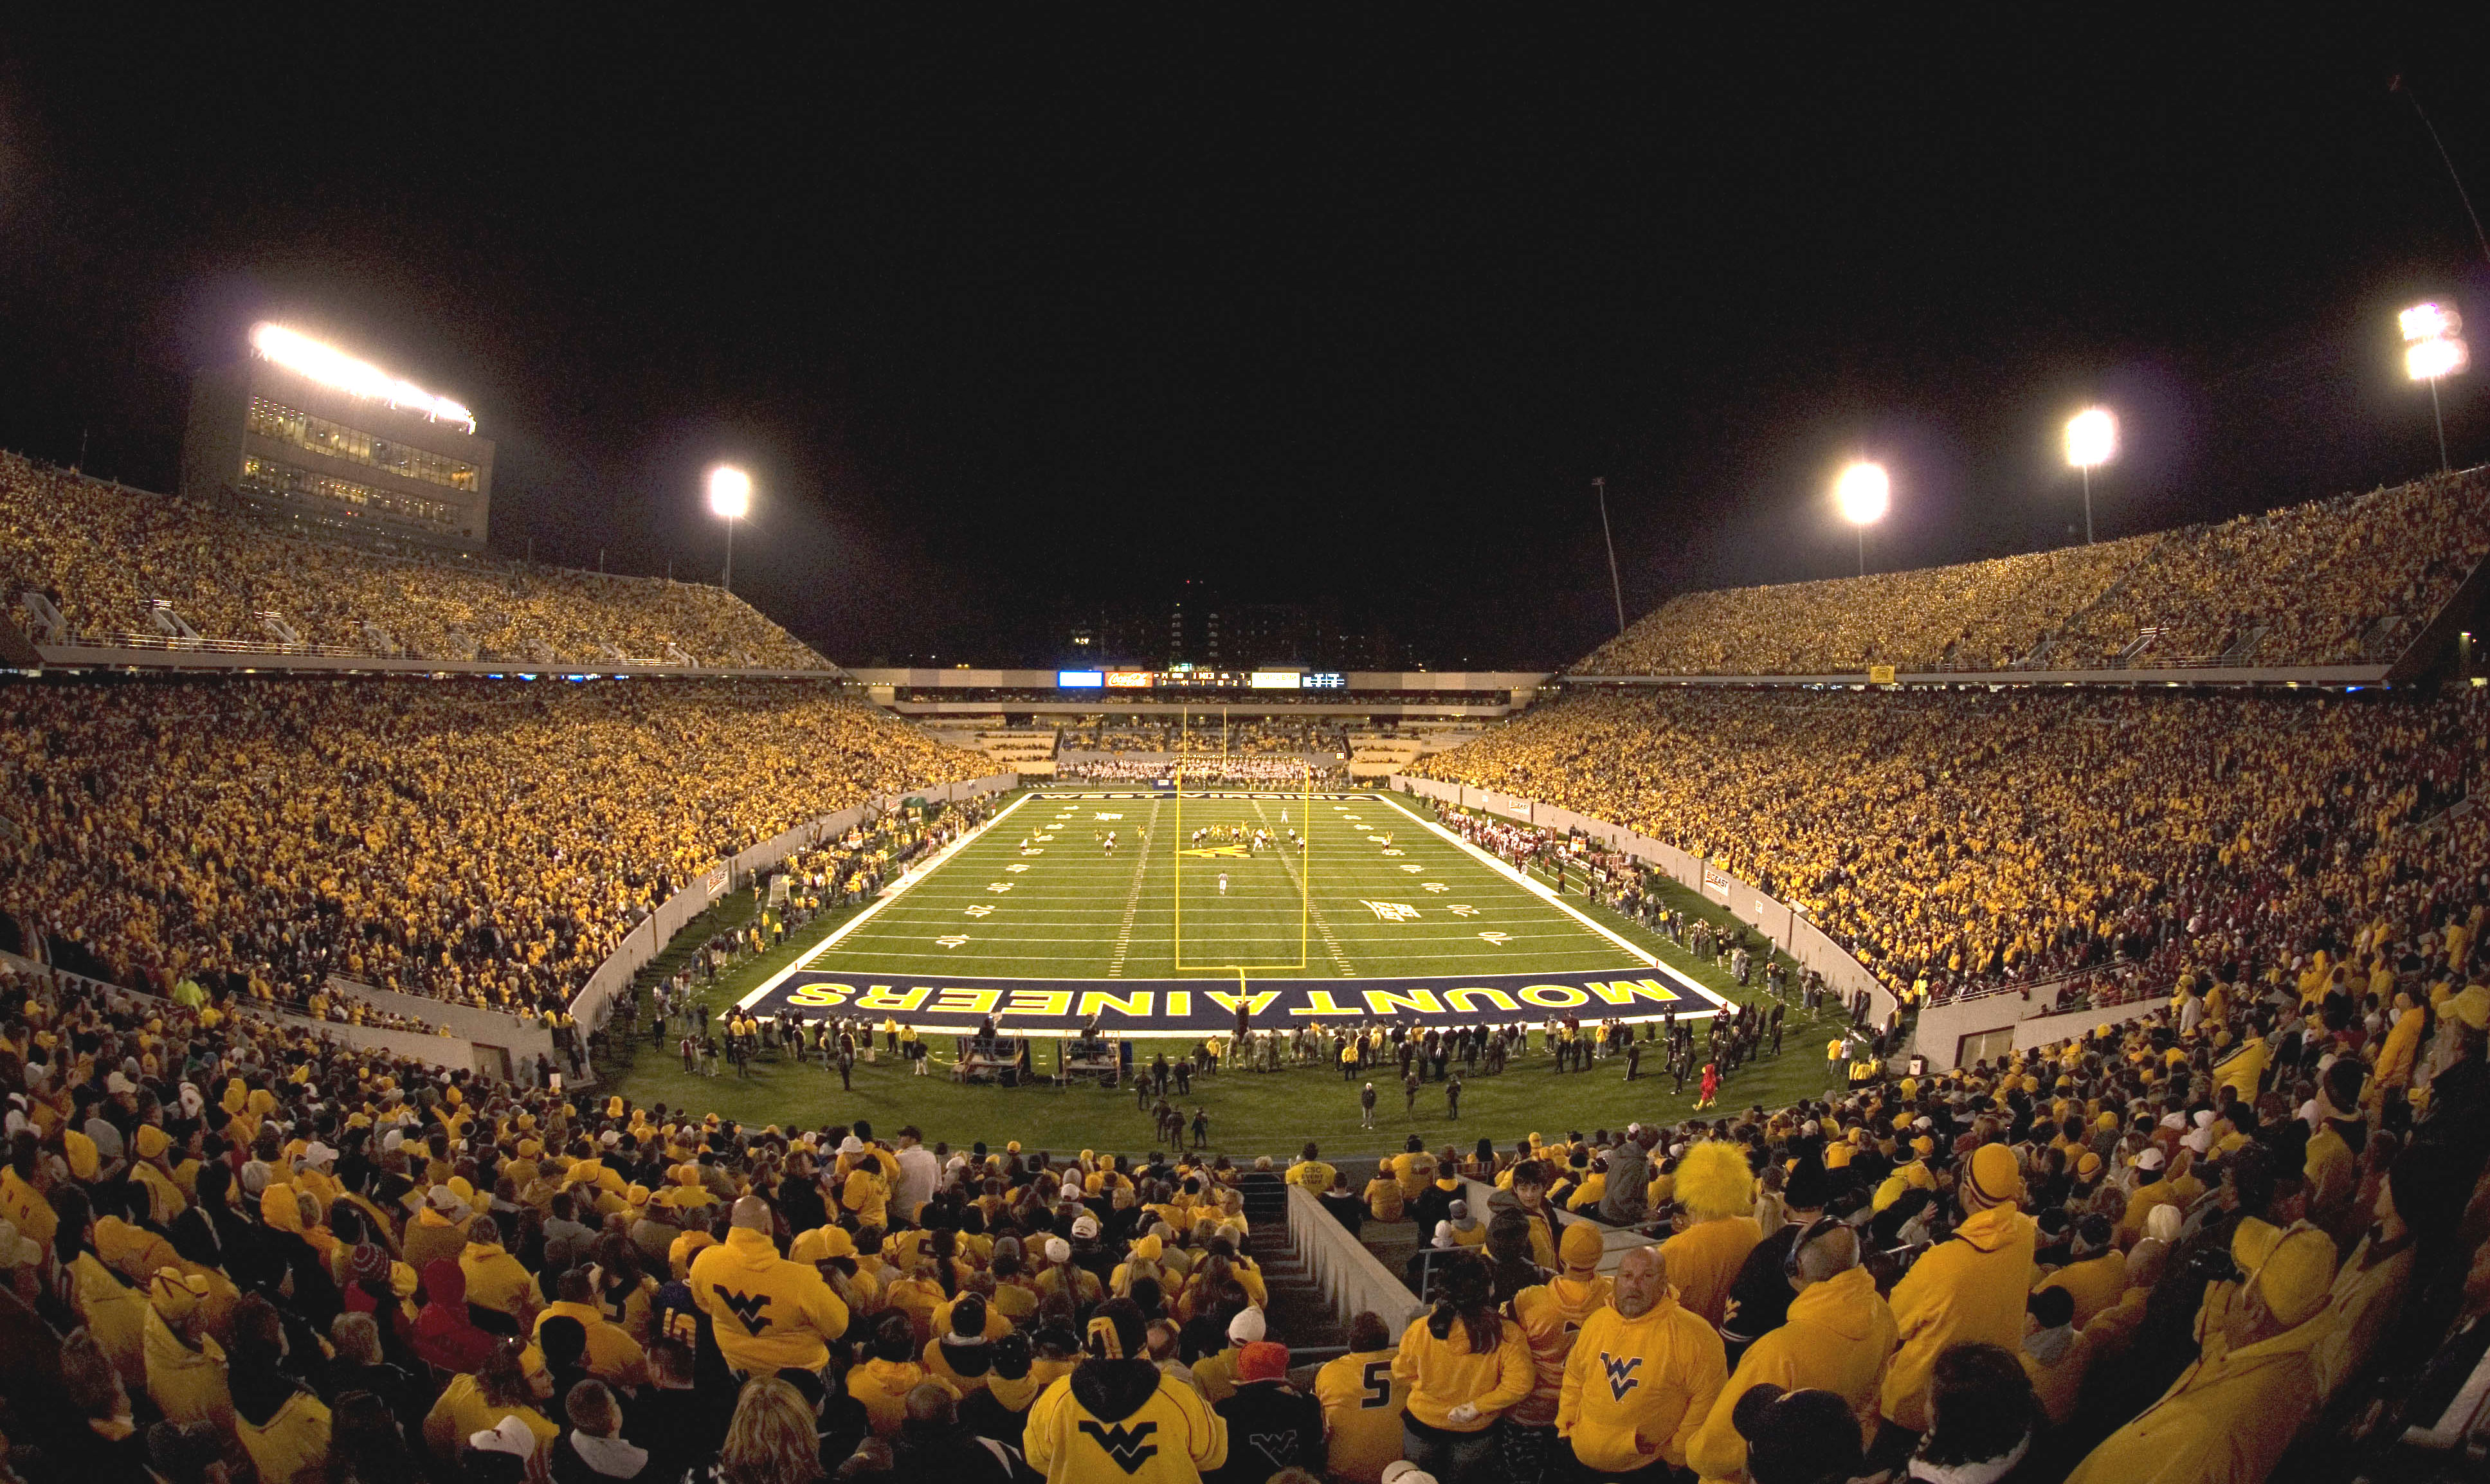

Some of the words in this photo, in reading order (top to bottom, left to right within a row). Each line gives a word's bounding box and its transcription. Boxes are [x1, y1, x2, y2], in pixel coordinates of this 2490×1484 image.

[986, 882, 1015, 891] 30
[1421, 882, 1450, 891] 30
[964, 905, 995, 914] 20
[1446, 904, 1480, 914] 20
[935, 934, 970, 945] 10
[1478, 931, 1513, 941] 10
[786, 978, 1683, 1017] MOUNTAINEERS
[1360, 1360, 1392, 1409] 5
